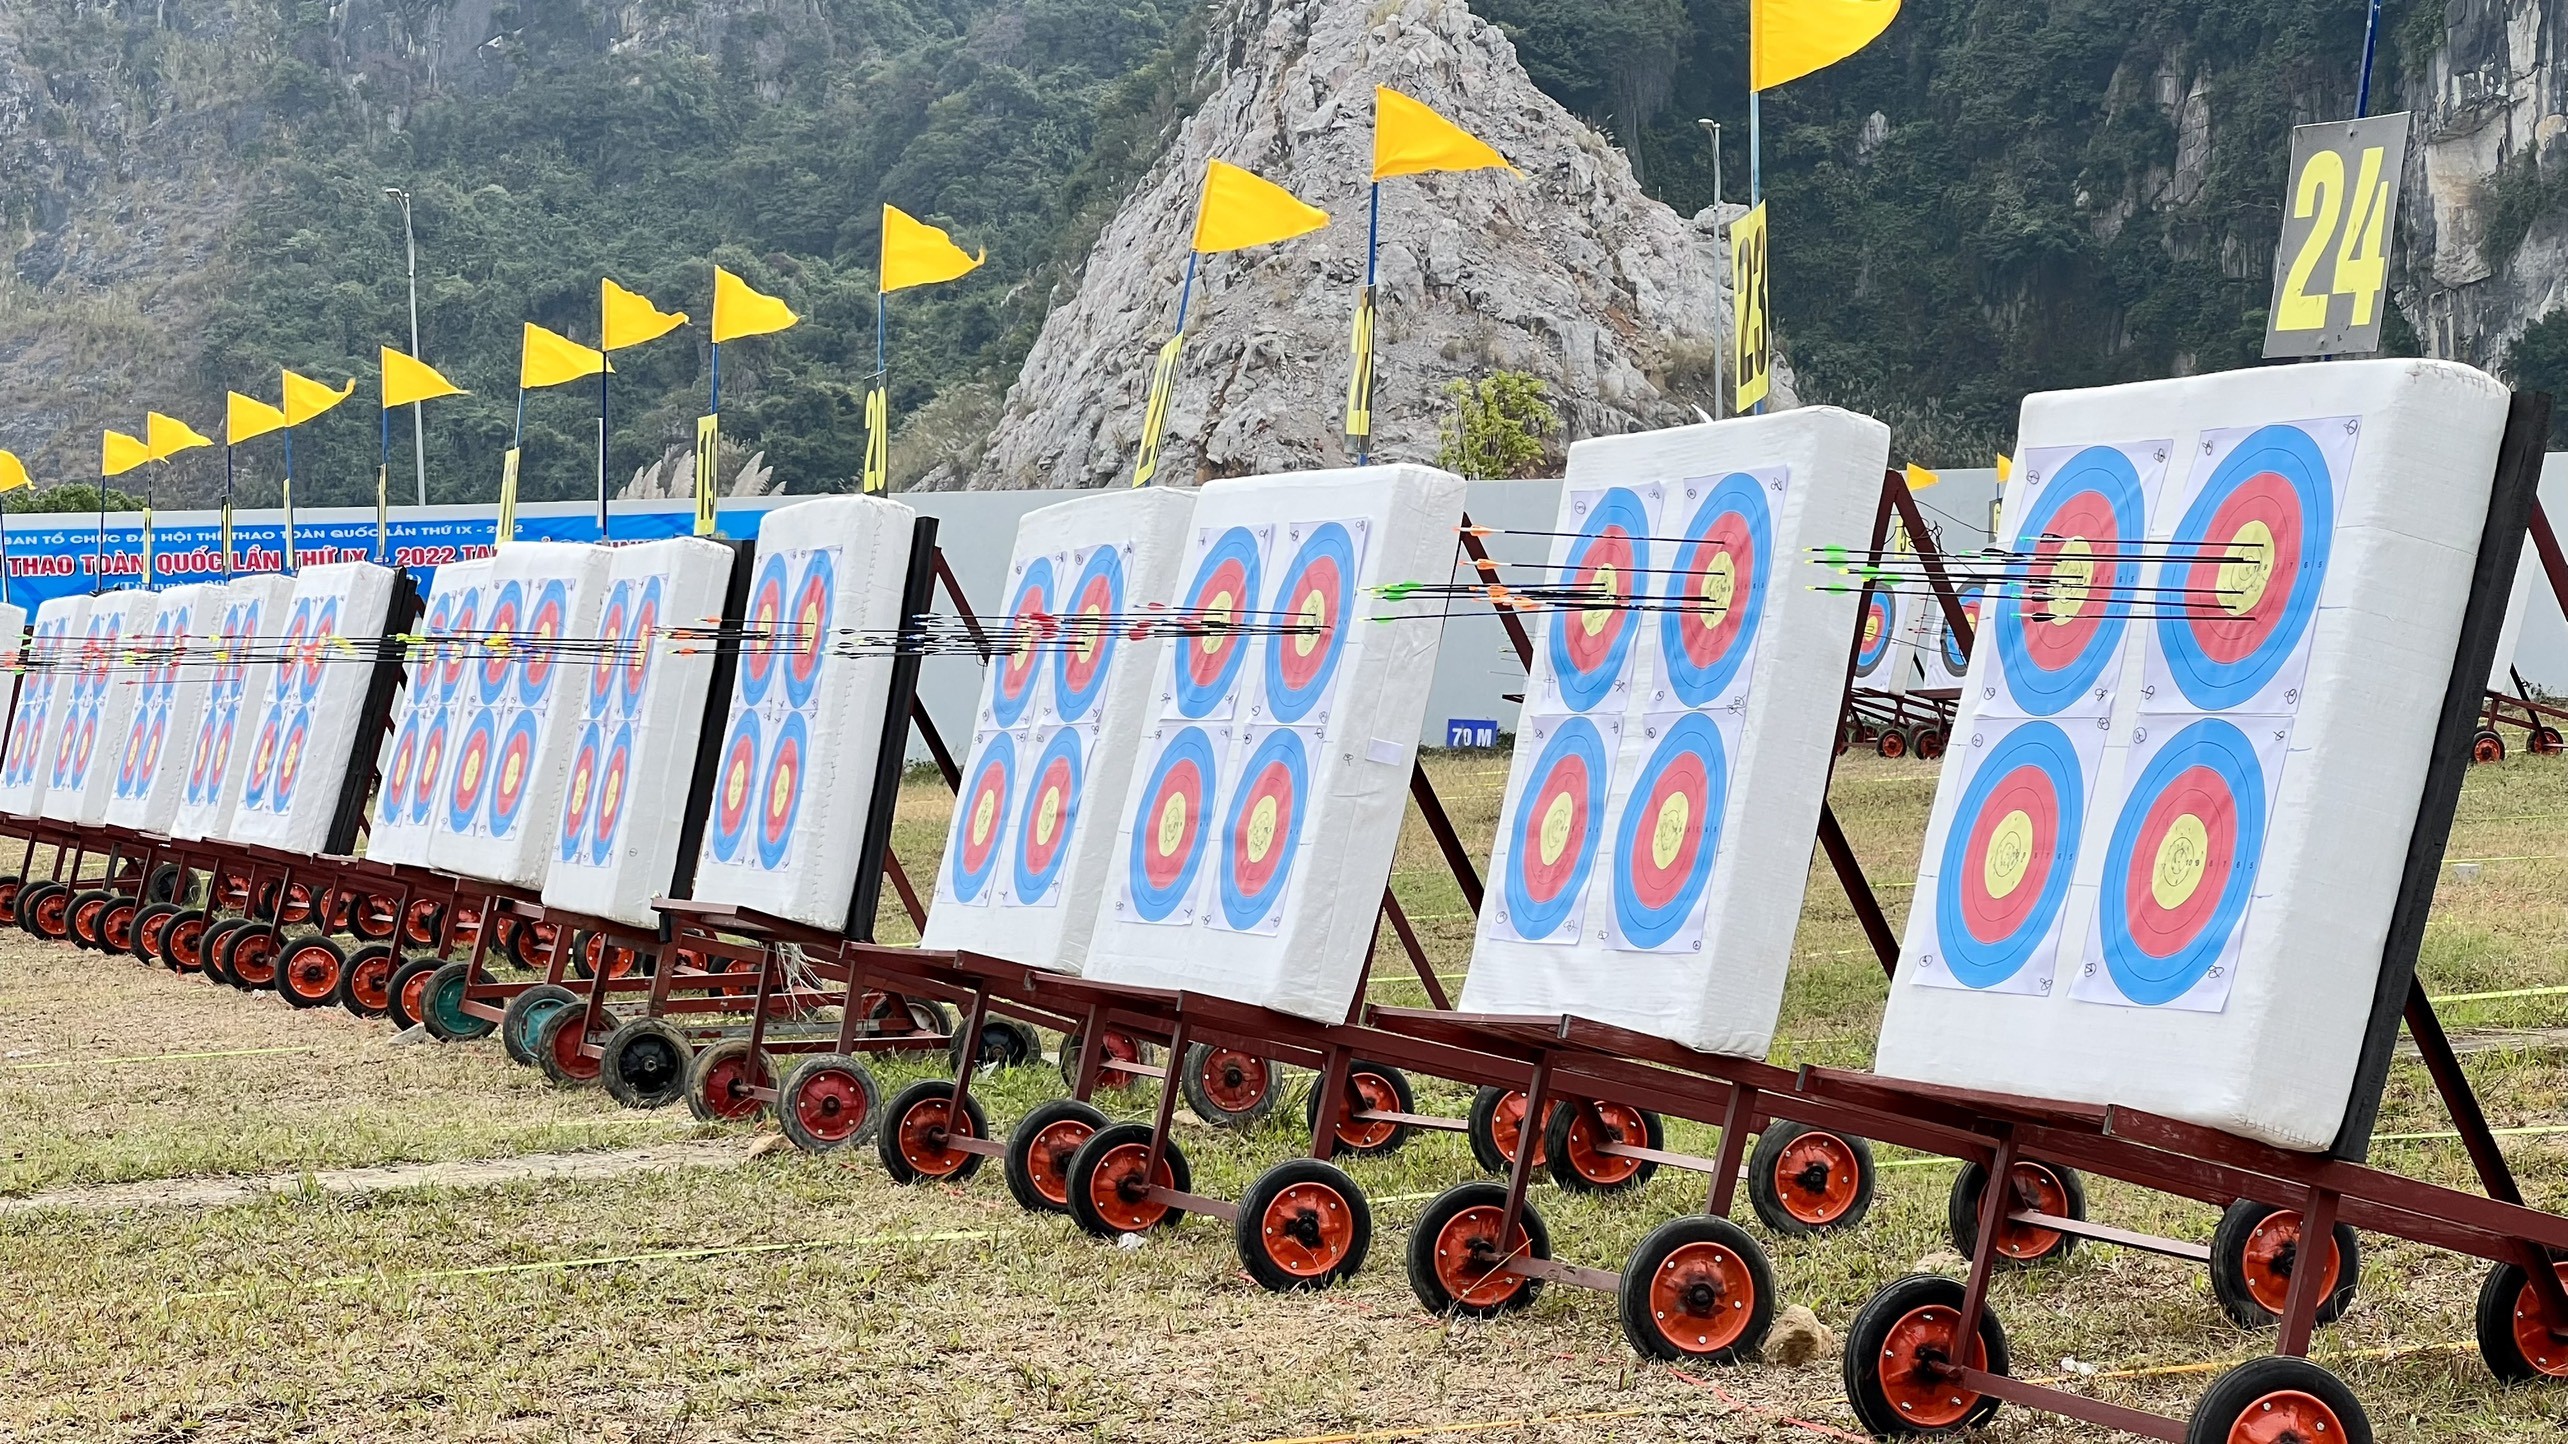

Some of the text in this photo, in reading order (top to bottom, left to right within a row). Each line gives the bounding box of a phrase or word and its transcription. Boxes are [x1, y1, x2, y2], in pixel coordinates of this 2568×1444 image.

[2275, 147, 2389, 331] 24
[1738, 225, 1767, 387] 23
[1346, 306, 1374, 436] 22
[700, 428, 716, 520] 19
[864, 386, 887, 493] 20
[4, 536, 38, 545] BAN
[161, 531, 192, 543] HỘI
[231, 531, 276, 541] THAO
[330, 526, 378, 538] QUỐC
[421, 525, 453, 535] THỨ
[456, 526, 472, 535] IX
[486, 525, 524, 534] 22
[6, 555, 75, 577] THAO
[80, 550, 144, 576] TOÀN
[156, 545, 222, 576] QUỐC
[232, 544, 282, 572] LẦN
[395, 546, 456, 567] 2022
[1452, 728, 1492, 747] 70 M
